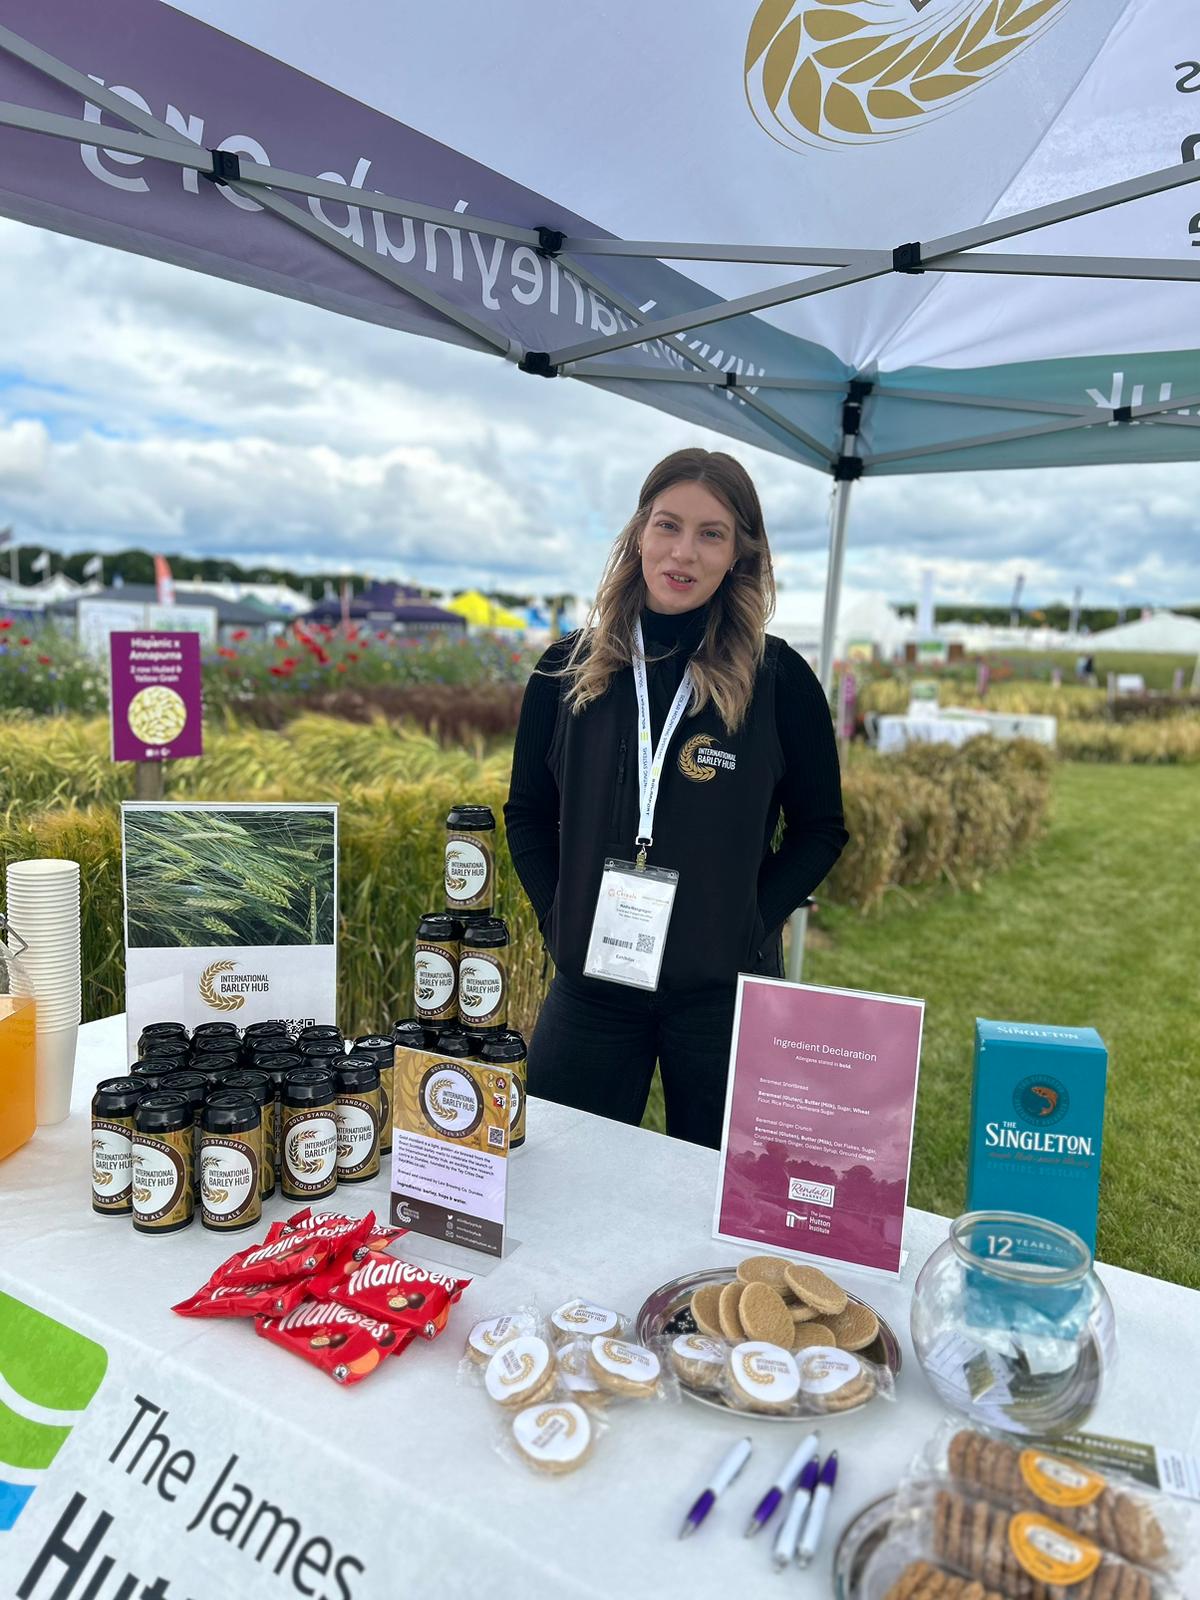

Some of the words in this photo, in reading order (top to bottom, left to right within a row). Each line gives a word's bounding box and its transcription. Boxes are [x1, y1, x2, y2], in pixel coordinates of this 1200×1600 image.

[698, 748, 736, 761] INTERNATIONAL
[697, 755, 722, 767] BARLEY
[722, 760, 736, 770] HUB
[451, 868, 471, 876] BARLEY
[221, 974, 269, 983] INTERNATIONAL
[420, 978, 438, 986] BARLEY
[440, 978, 452, 986] HUB
[221, 983, 250, 993] BARLEY
[251, 982, 269, 992] HUB
[466, 985, 486, 993] BARLEY
[773, 1037, 820, 1052] Ingredient
[822, 1045, 877, 1062] Declaration
[443, 1091, 475, 1104] INTERNATIONAL
[443, 1098, 462, 1109] BARLEY
[462, 1102, 475, 1112] HUB
[853, 1107, 870, 1115] Wheat
[96, 1123, 131, 1136] STANDARD
[360, 1132, 372, 1140] HUB
[985, 1122, 1092, 1155] SINGLETON
[136, 1137, 170, 1153] STANDARD
[211, 1140, 247, 1152] STANDARD
[304, 1144, 327, 1158] BARLEY
[95, 1160, 118, 1170] BARLEY
[135, 1168, 173, 1177] INTERNATIONAL
[209, 1168, 249, 1178] INTERNATIONAL
[135, 1177, 156, 1187] BARLEY
[157, 1177, 174, 1186] HUB
[209, 1177, 233, 1187] BARLEY
[235, 1175, 250, 1186] HUB
[228, 1210, 240, 1219] ALE
[810, 1217, 831, 1227] Hutton
[809, 1225, 830, 1234] Institute
[987, 1235, 1013, 1256] 12
[1015, 1238, 1052, 1250] YEARS
[348, 1259, 457, 1295] Maltesers
[108, 1394, 196, 1502] The
[186, 1454, 366, 1600] James
